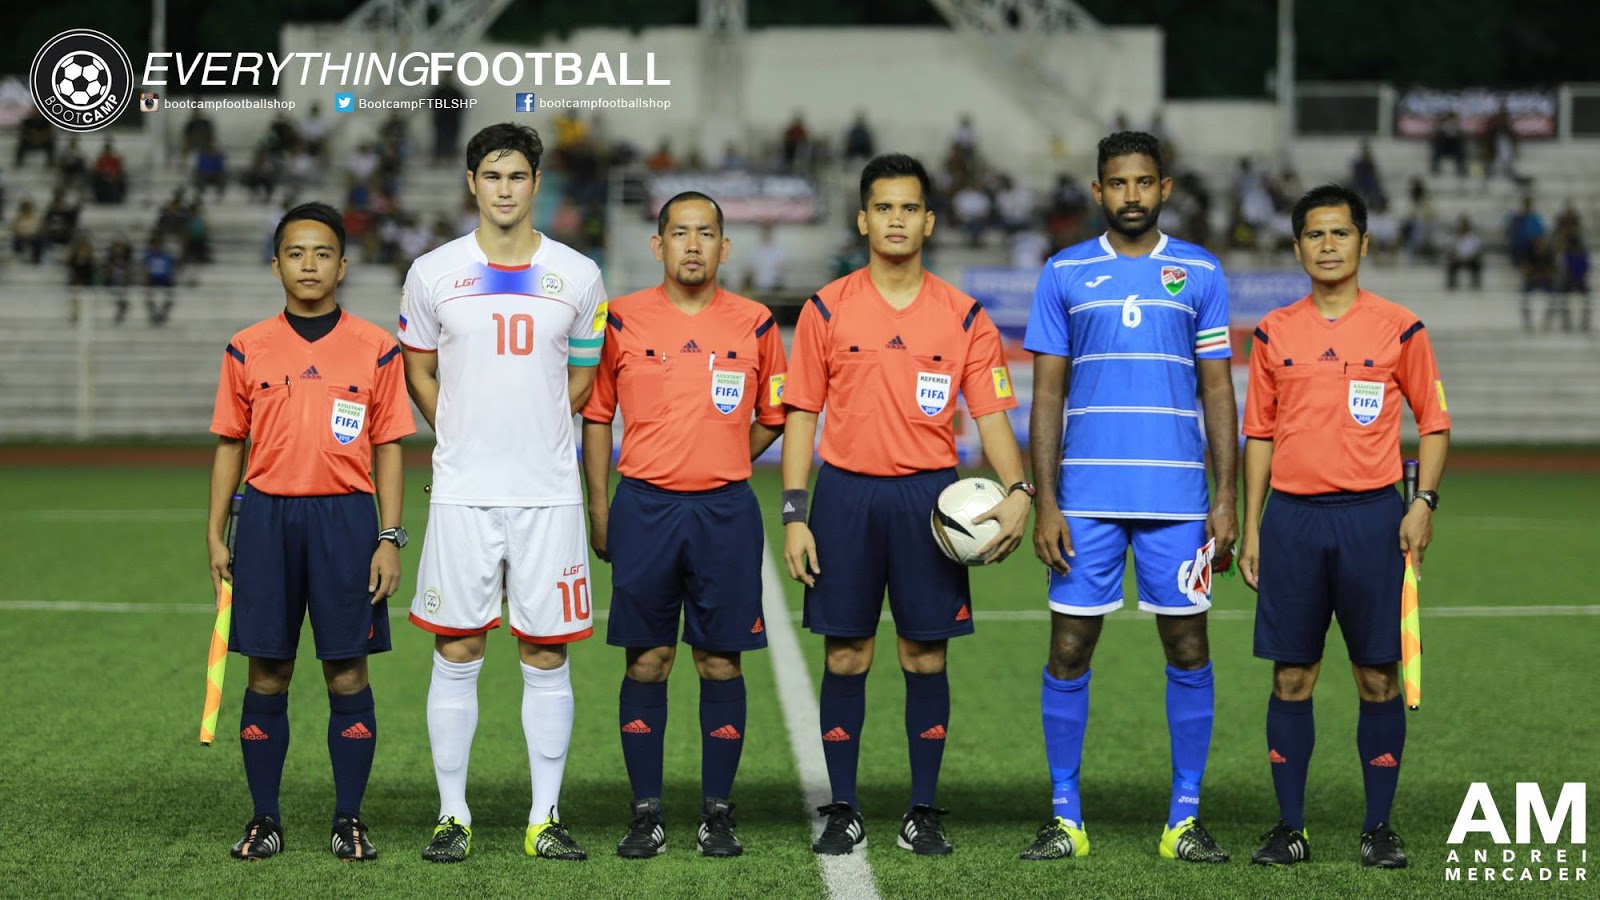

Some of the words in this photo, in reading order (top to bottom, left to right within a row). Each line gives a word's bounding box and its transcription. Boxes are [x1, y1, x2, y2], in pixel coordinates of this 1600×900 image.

[1122, 295, 1142, 328] 6
[492, 313, 534, 356] 10
[920, 375, 949, 384] REFEREE
[715, 386, 739, 398] FIFA
[920, 388, 945, 401] FIFA
[1353, 397, 1379, 409] FIFA
[335, 415, 358, 429] FIFA
[557, 577, 590, 623] 10
